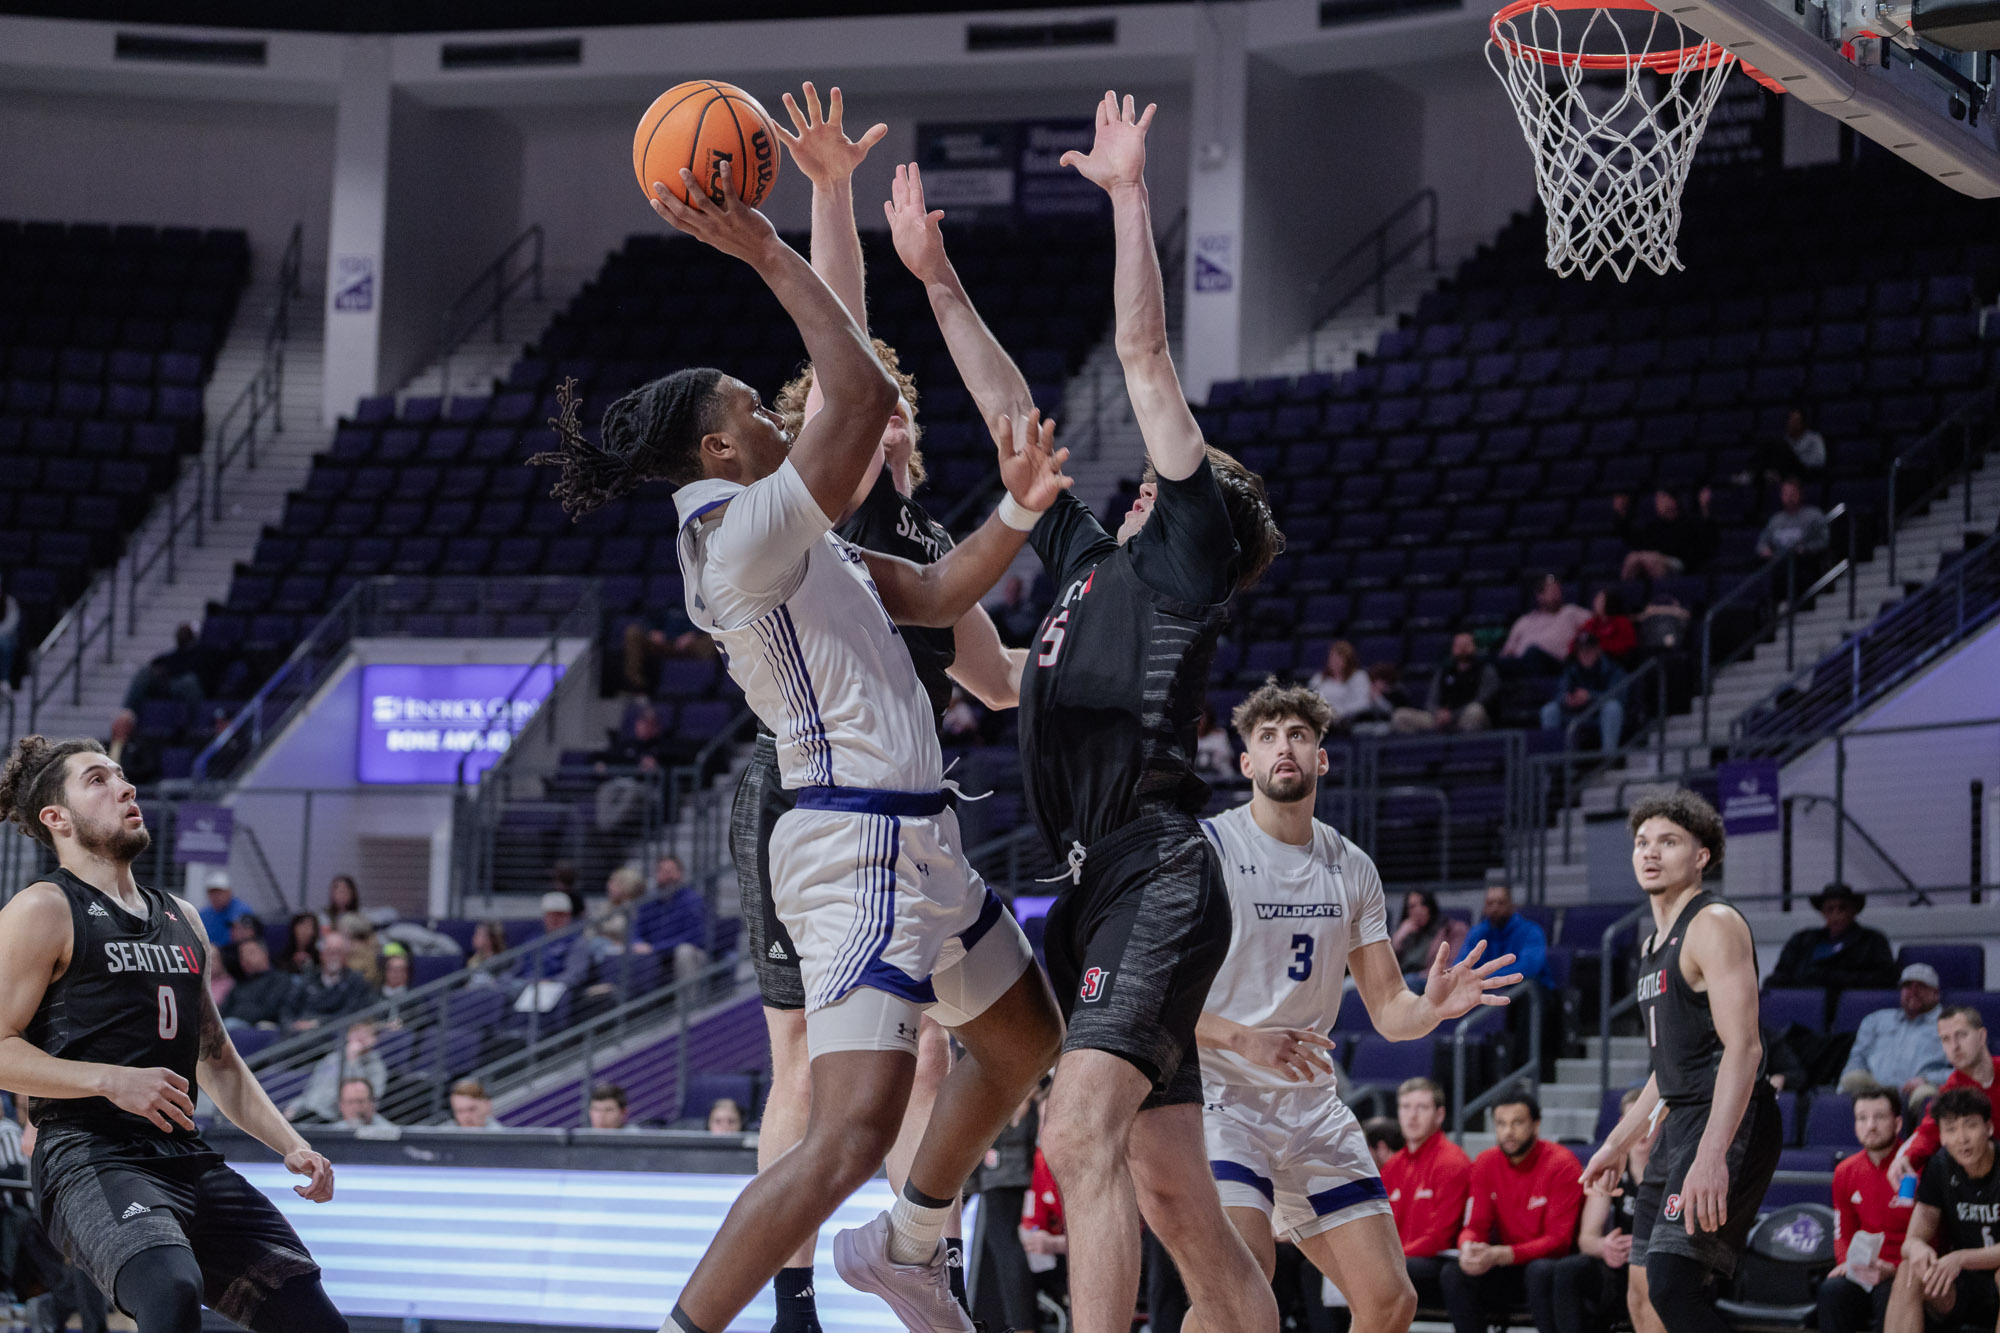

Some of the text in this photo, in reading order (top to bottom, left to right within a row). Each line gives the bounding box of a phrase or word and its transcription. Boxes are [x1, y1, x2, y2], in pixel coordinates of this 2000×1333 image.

[710, 148, 733, 207] NCA
[751, 126, 773, 209] Wilso
[1038, 609, 1070, 668] 5
[1254, 902, 1343, 920] WILDCATS
[1287, 933, 1315, 982] 3
[1637, 968, 1667, 1002] EATTLEU
[157, 984, 178, 1040] 0
[1649, 1004, 1657, 1048] 1
[1956, 1202, 2000, 1223] SEATTLE
